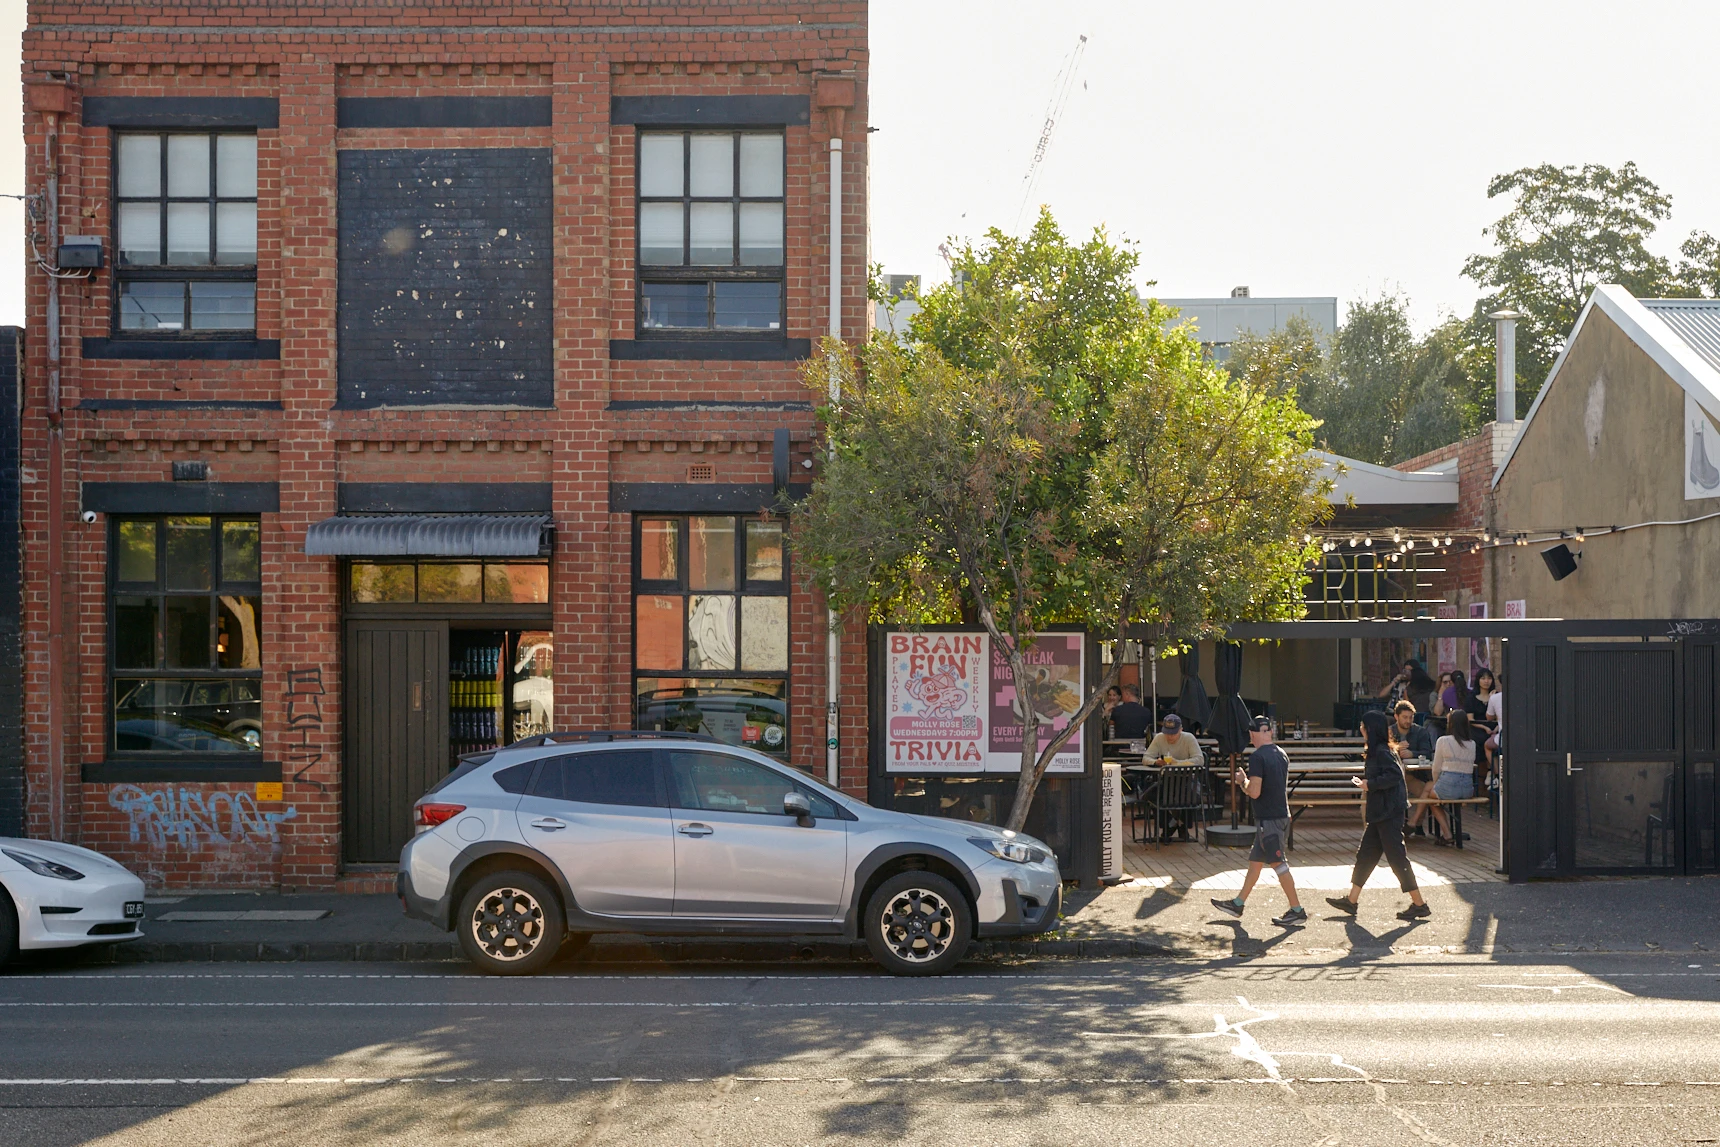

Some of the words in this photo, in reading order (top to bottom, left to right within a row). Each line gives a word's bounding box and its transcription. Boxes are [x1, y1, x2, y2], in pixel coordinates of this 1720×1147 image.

[1323, 552, 1436, 620] ROSE
[890, 635, 982, 654] BRAIN
[909, 654, 967, 680] FUN
[993, 666, 1013, 680] NIG
[891, 656, 899, 712] PLAYED
[971, 657, 981, 713] WEEKLY
[893, 729, 947, 737] WEDNESDAYS
[948, 729, 979, 737] 7:00PM
[911, 720, 938, 728] MOLLY
[993, 726, 1017, 736] EVERY
[889, 740, 982, 761] TRIVIA
[1055, 757, 1069, 765] MOLLY
[1069, 757, 1081, 765] ROSE
